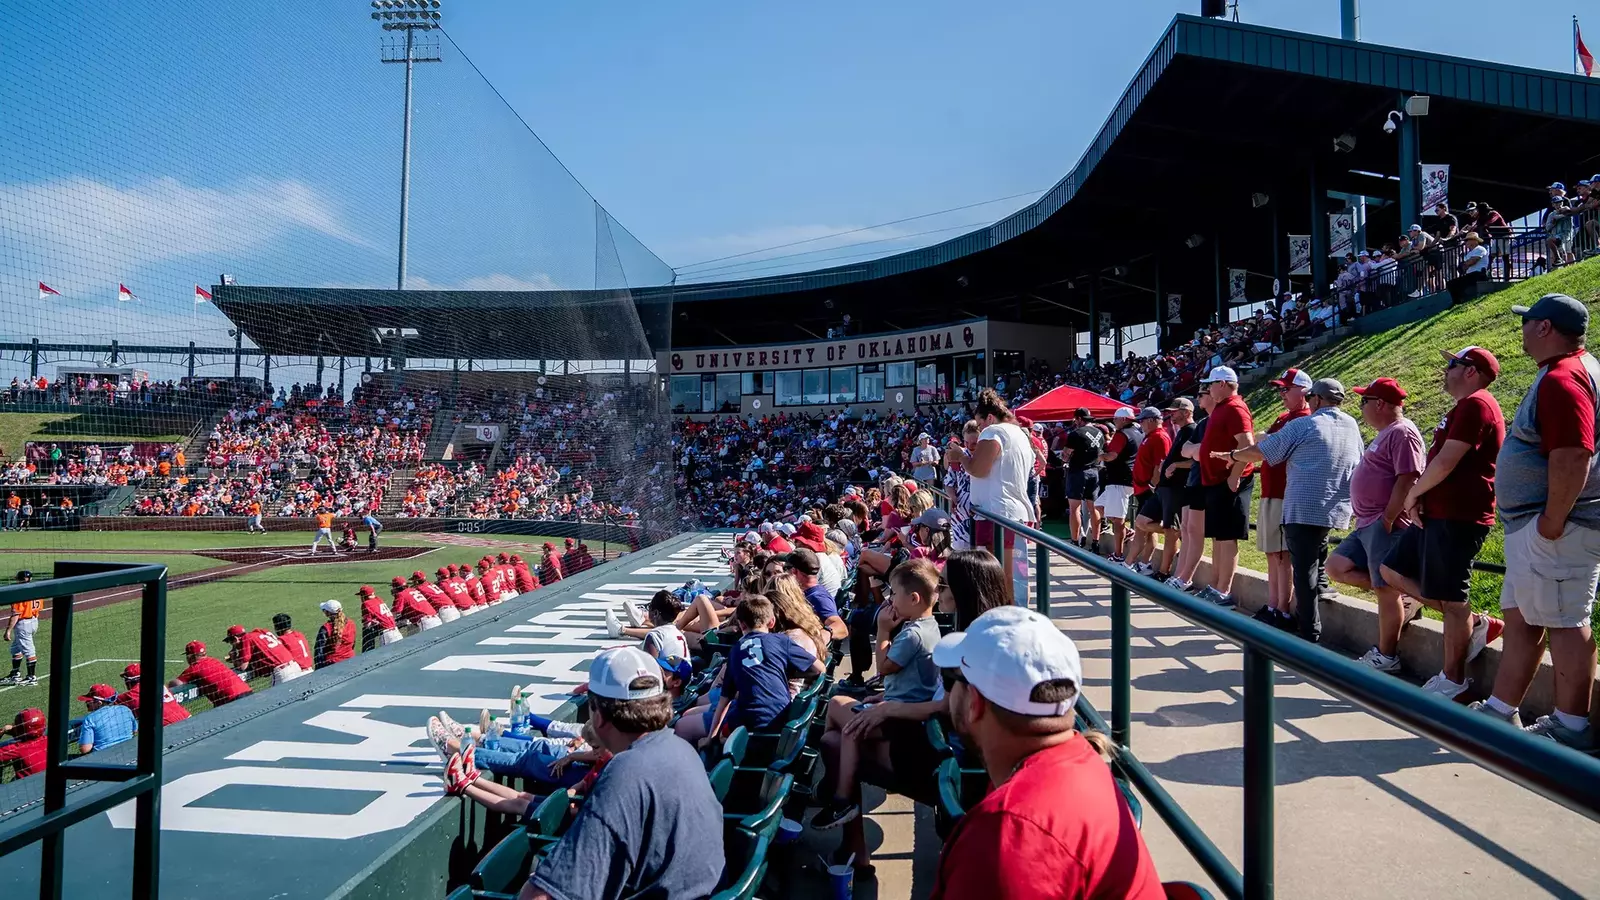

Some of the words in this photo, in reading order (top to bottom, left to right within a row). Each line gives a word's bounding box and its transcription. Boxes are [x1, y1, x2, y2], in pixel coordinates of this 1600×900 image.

[696, 348, 815, 369] UNIVERSITY
[827, 345, 846, 361] OF
[858, 332, 954, 359] OKLAHOMA
[483, 427, 493, 440] OU
[458, 521, 480, 533] 0:05
[299, 640, 308, 657] 1
[740, 638, 764, 668] 3
